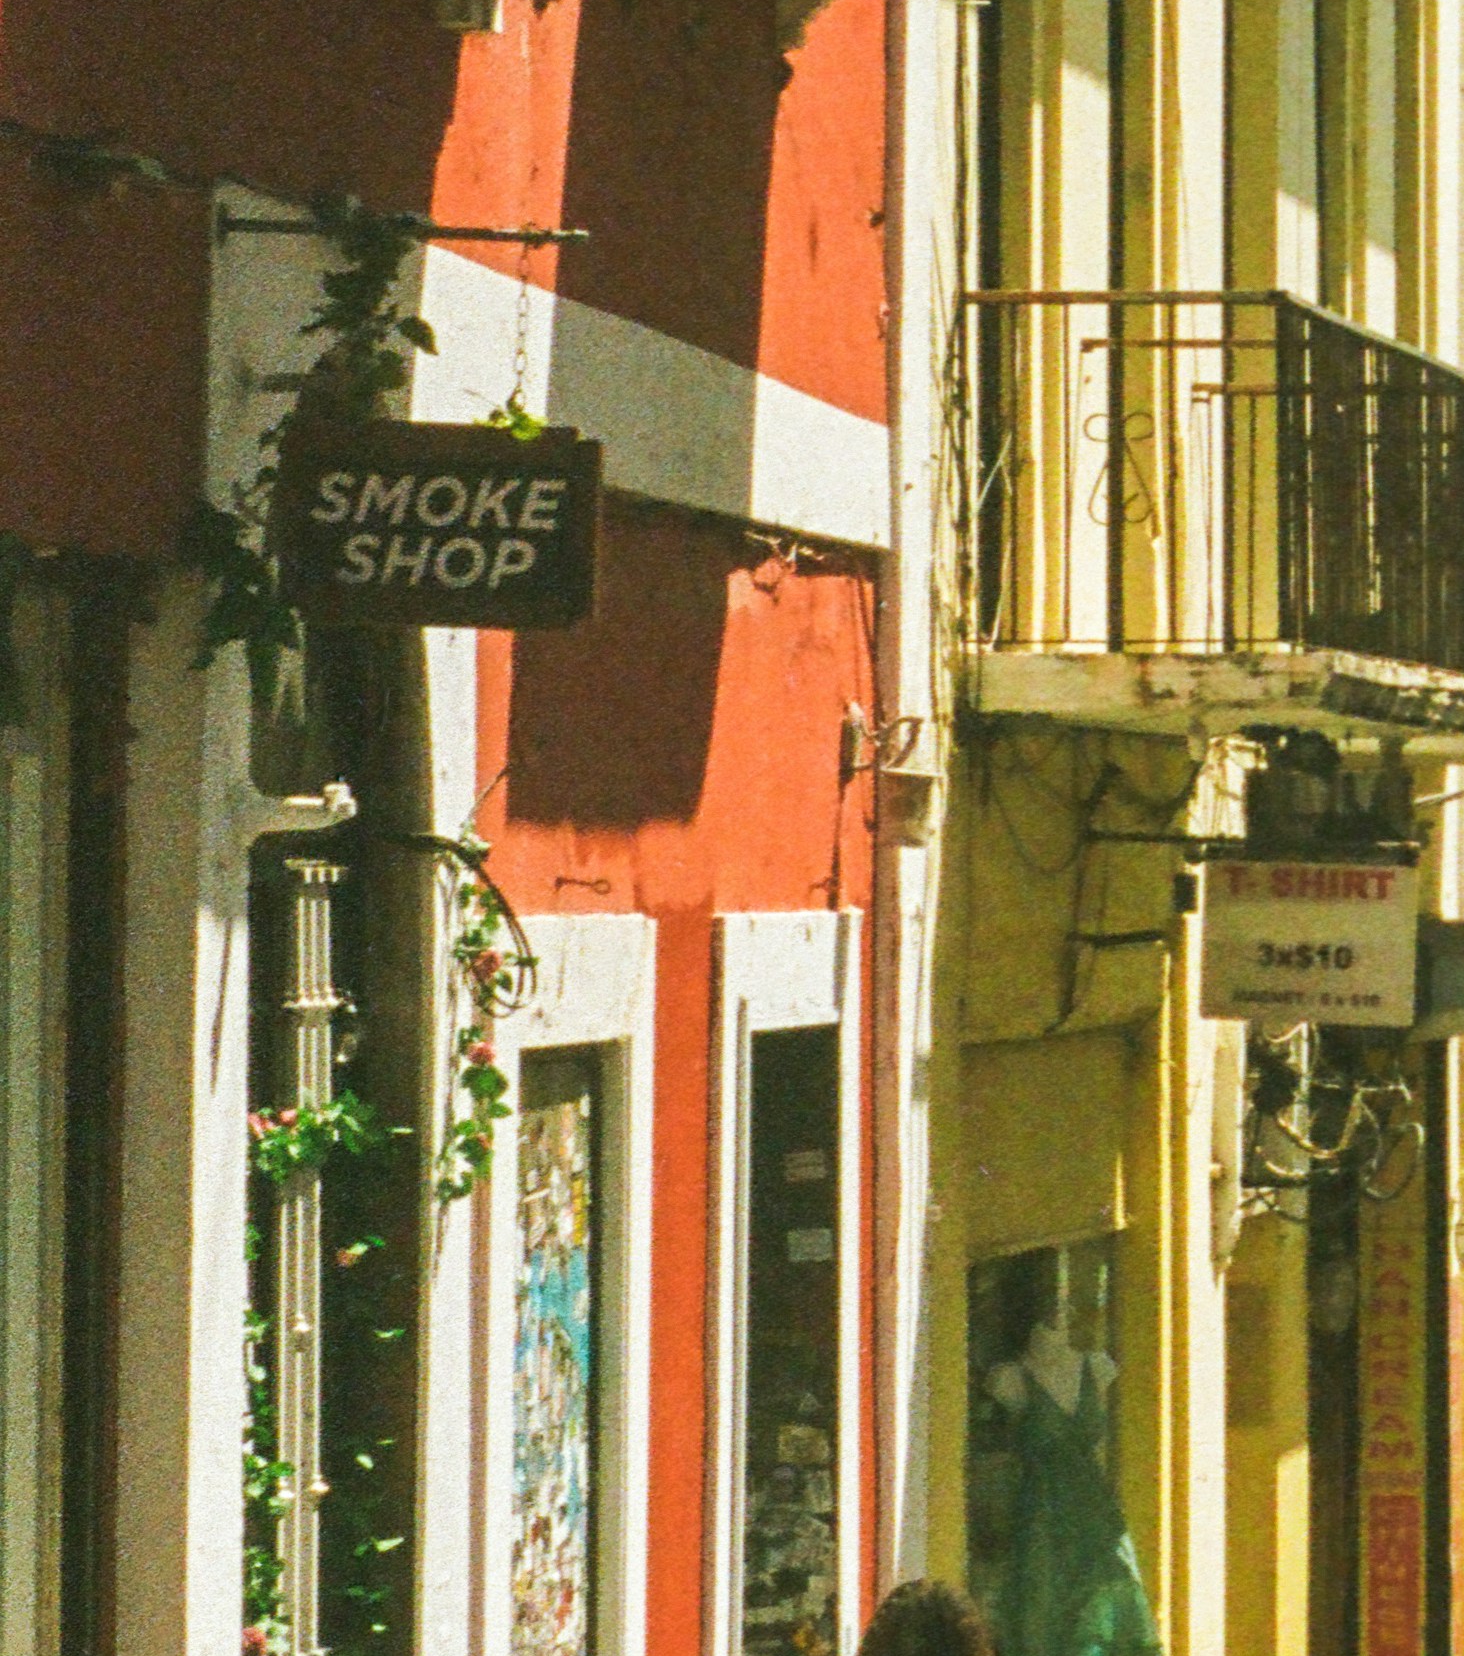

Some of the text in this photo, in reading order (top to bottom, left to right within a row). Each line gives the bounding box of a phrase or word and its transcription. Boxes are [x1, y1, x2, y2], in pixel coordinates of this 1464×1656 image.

[309, 470, 567, 530] SMOKE
[338, 534, 536, 590] SHOP
[1271, 867, 1395, 900] SHIRT
